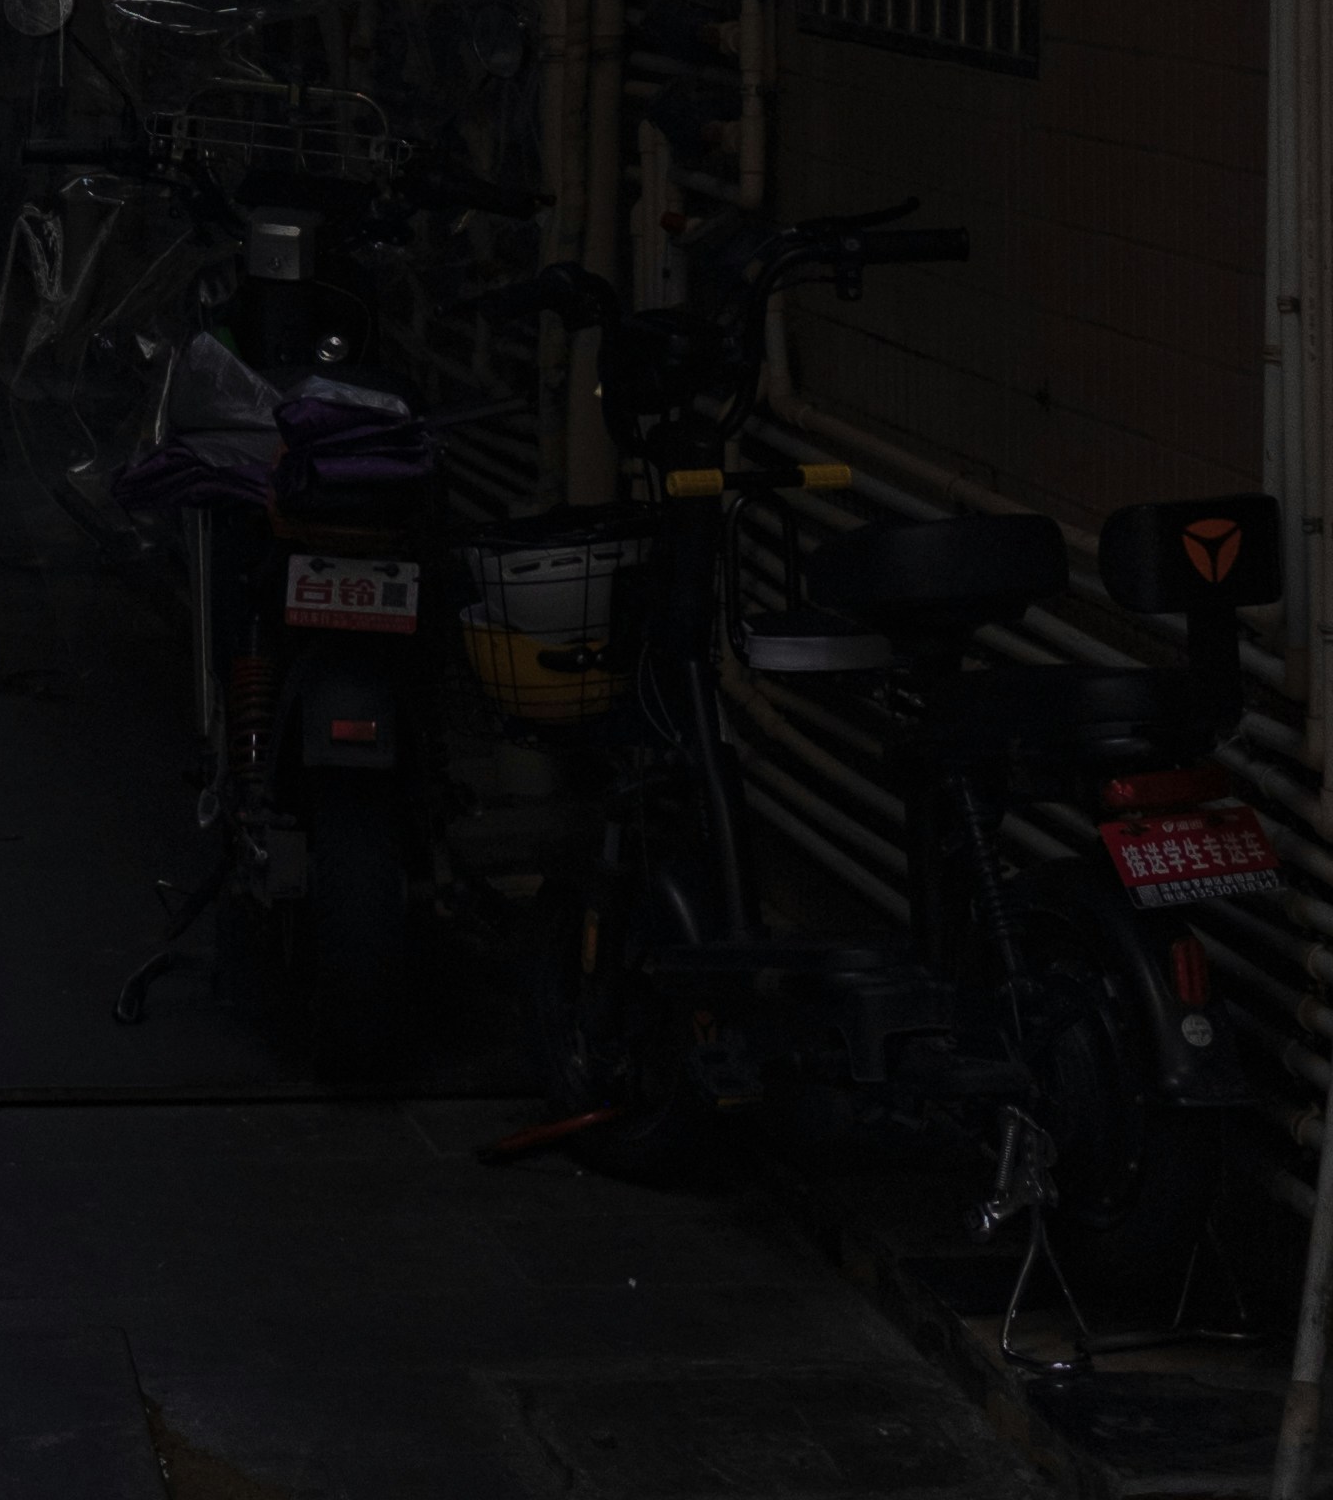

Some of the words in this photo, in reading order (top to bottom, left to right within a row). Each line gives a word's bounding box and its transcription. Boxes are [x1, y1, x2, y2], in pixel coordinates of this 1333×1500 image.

[295, 575, 375, 607] 台铃
[1121, 830, 1266, 878] 接送学生专送车
